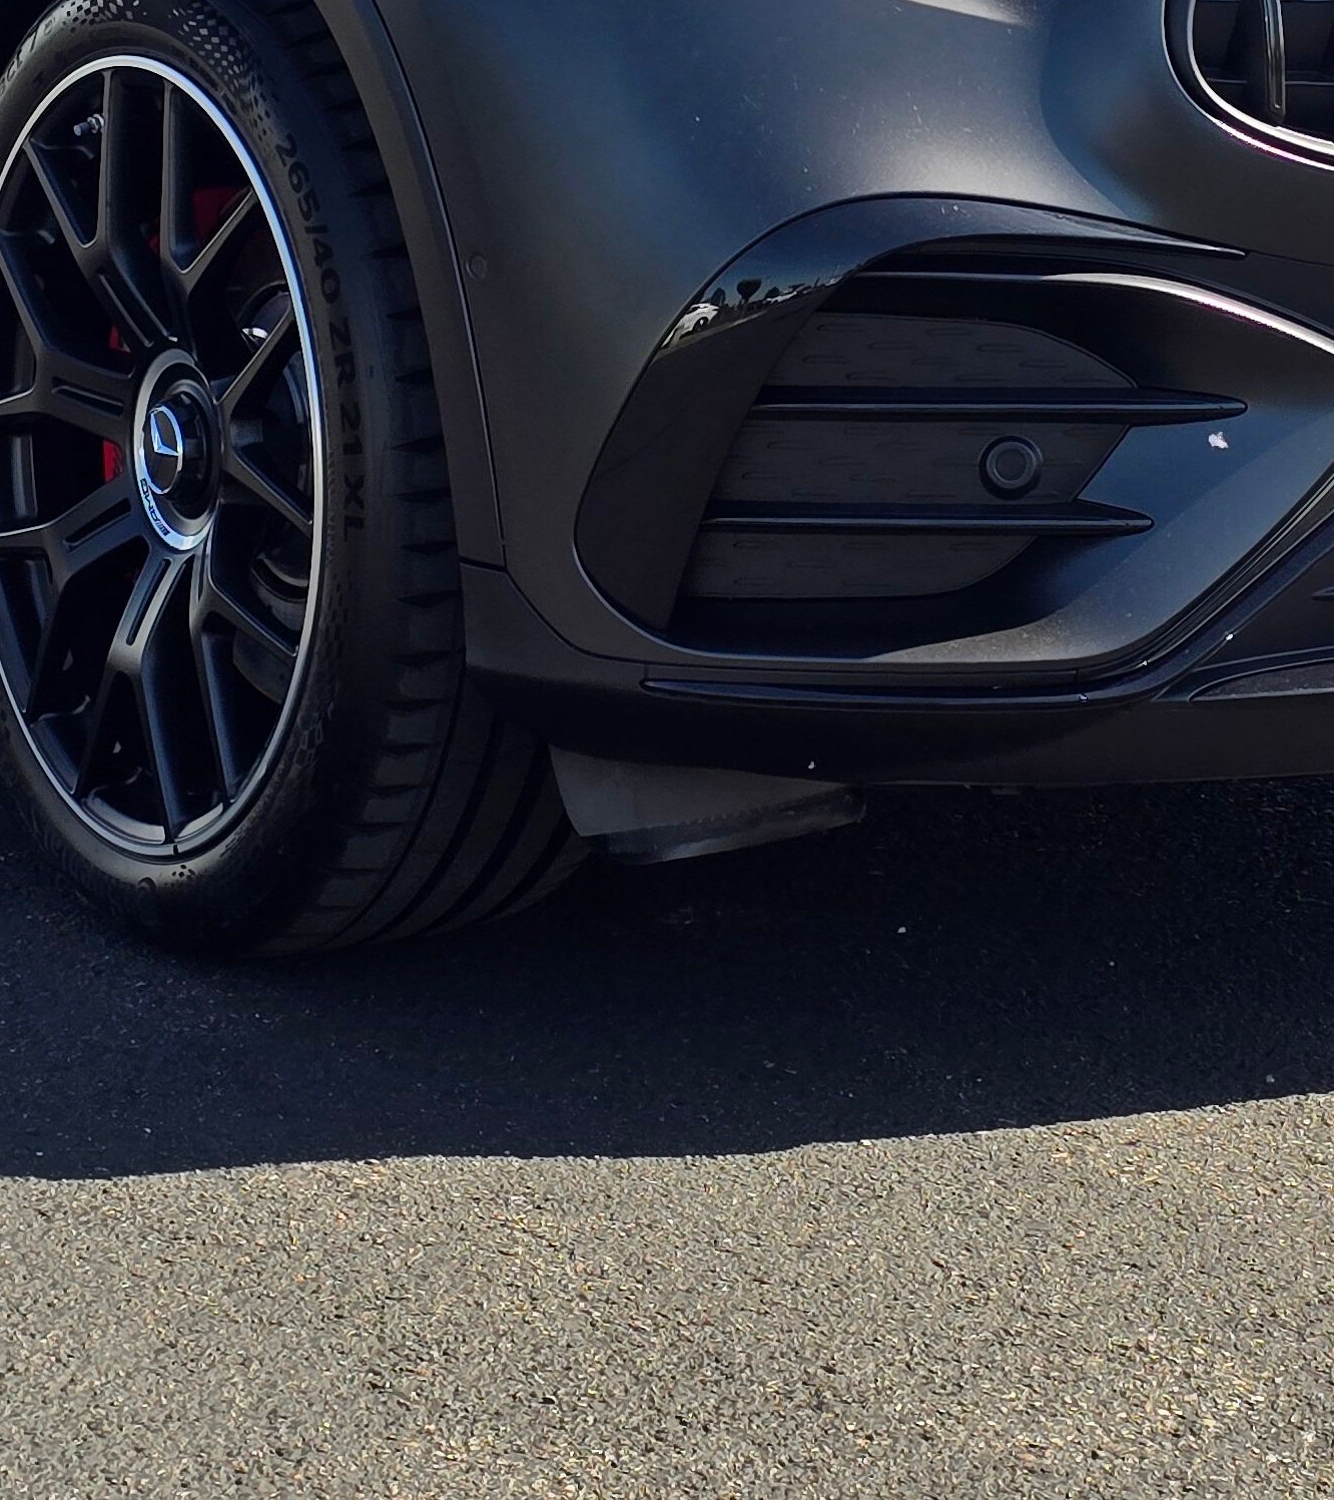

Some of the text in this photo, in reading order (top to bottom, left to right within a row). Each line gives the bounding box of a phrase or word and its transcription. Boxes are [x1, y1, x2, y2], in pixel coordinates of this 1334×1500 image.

[274, 133, 366, 542] 265/40 ZR 21 XL
[140, 478, 163, 525] AMG
